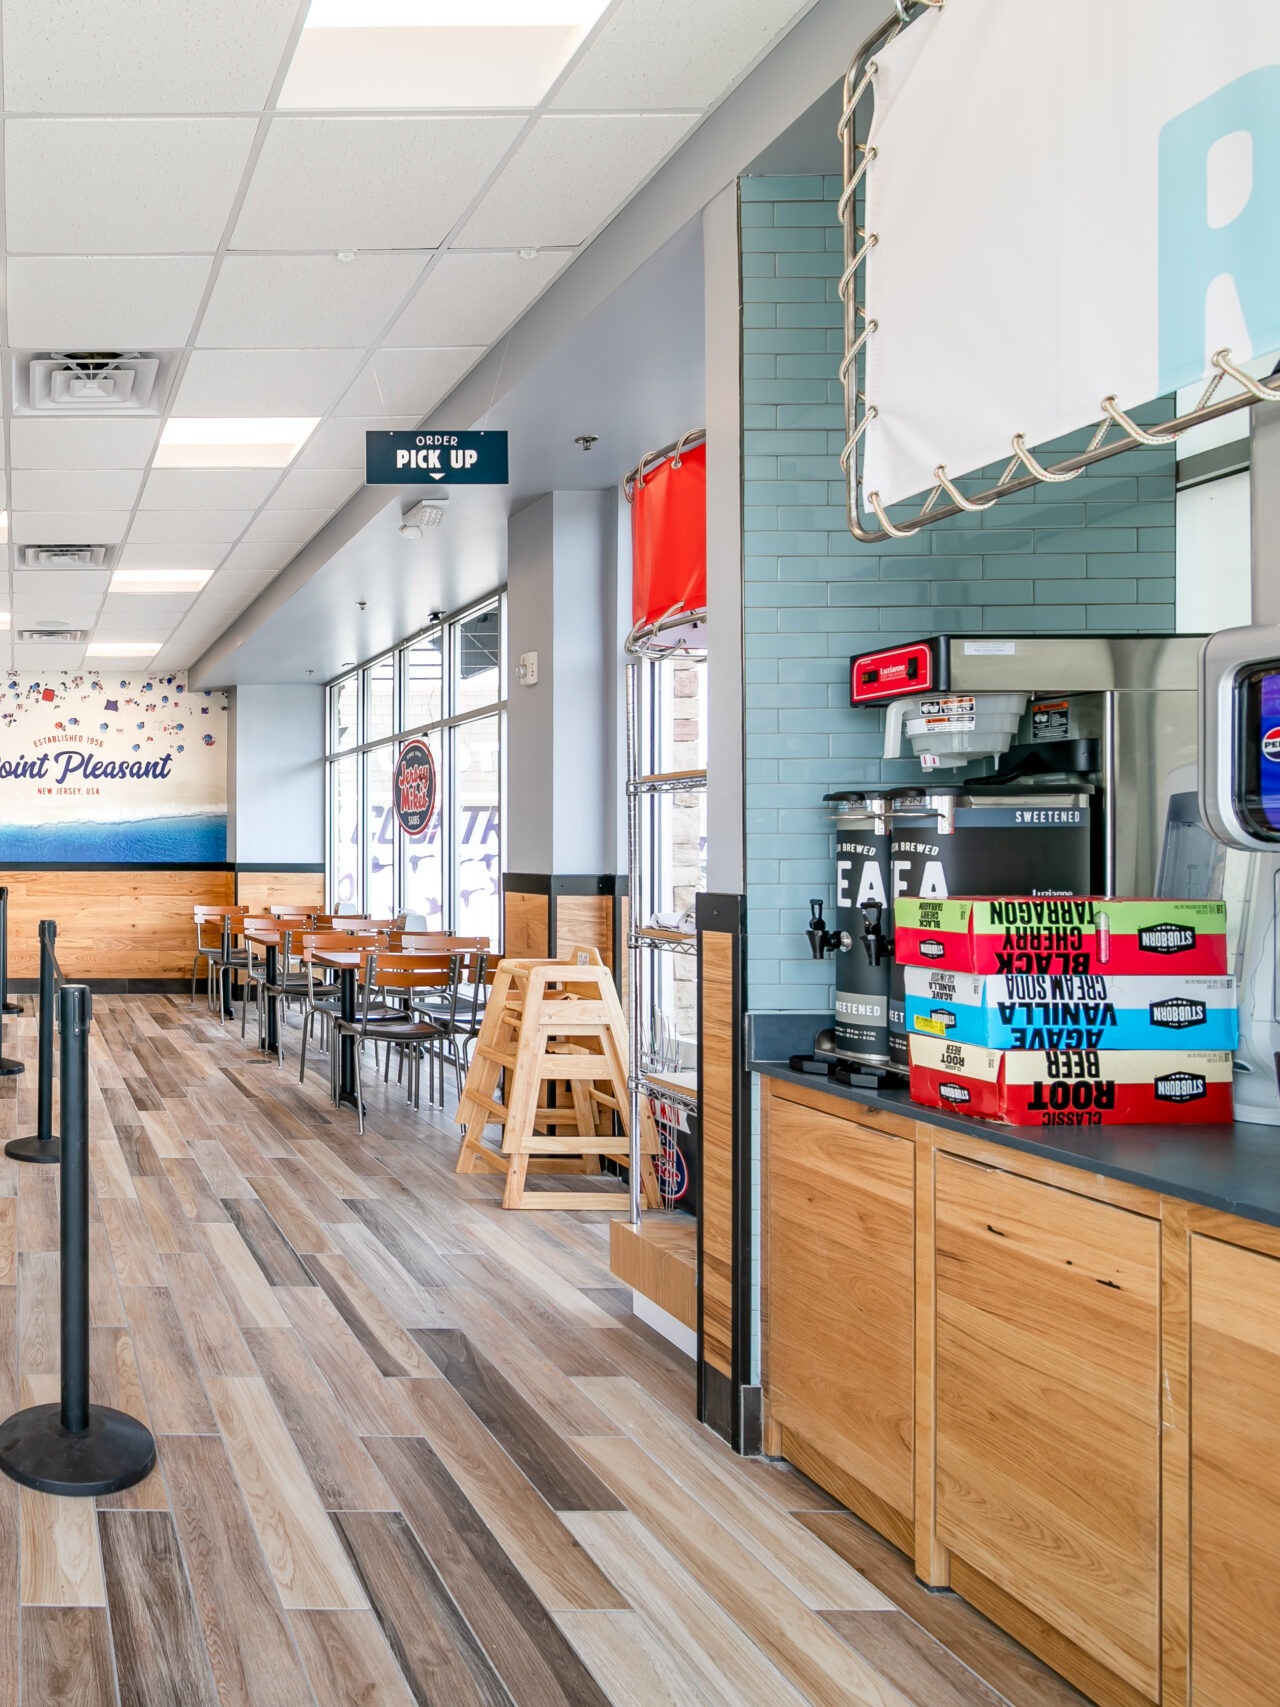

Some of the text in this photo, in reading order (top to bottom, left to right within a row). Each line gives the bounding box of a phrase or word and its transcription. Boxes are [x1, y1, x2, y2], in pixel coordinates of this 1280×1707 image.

[415, 436, 458, 447] ORDER
[396, 449, 478, 470] PICK UP
[880, 664, 906, 675] Luzianne
[33, 734, 105, 748] ESTABLISHED 1956
[53, 750, 173, 785] Pleasant
[398, 761, 429, 789] Jersey
[37, 787, 53, 795] NEW
[86, 787, 100, 795] USA
[400, 786, 429, 813] Mike's
[408, 815, 420, 826] SUBS
[1016, 811, 1080, 823] SWEETENED
[842, 843, 877, 856] BREWED
[900, 842, 940, 856] BREWED
[919, 903, 943, 912] TARRAGON
[989, 902, 1096, 925] TARRAGON
[920, 912, 939, 921] CHERRY
[919, 920, 941, 930] BLACK
[1001, 926, 1082, 951] CHERRY
[1142, 930, 1193, 948] STUBBORN
[920, 942, 944, 956] STUBBORN
[995, 953, 1091, 976] BLACK
[928, 982, 957, 994] VANILLA
[1006, 975, 1108, 1001] CREAM SODA
[931, 990, 953, 1001] AGAVE
[997, 1002, 1118, 1027] VANILLA
[1153, 1006, 1204, 1022] STUBBORN
[1010, 1029, 1106, 1050] AGAVE
[946, 1044, 962, 1056] BEER
[940, 1053, 965, 1067] ROOT
[1045, 1051, 1100, 1079] BEER
[1157, 1079, 1204, 1096] STUBBORN
[1027, 1080, 1115, 1111] ROOT
[1042, 1111, 1102, 1126] CLASSIC
